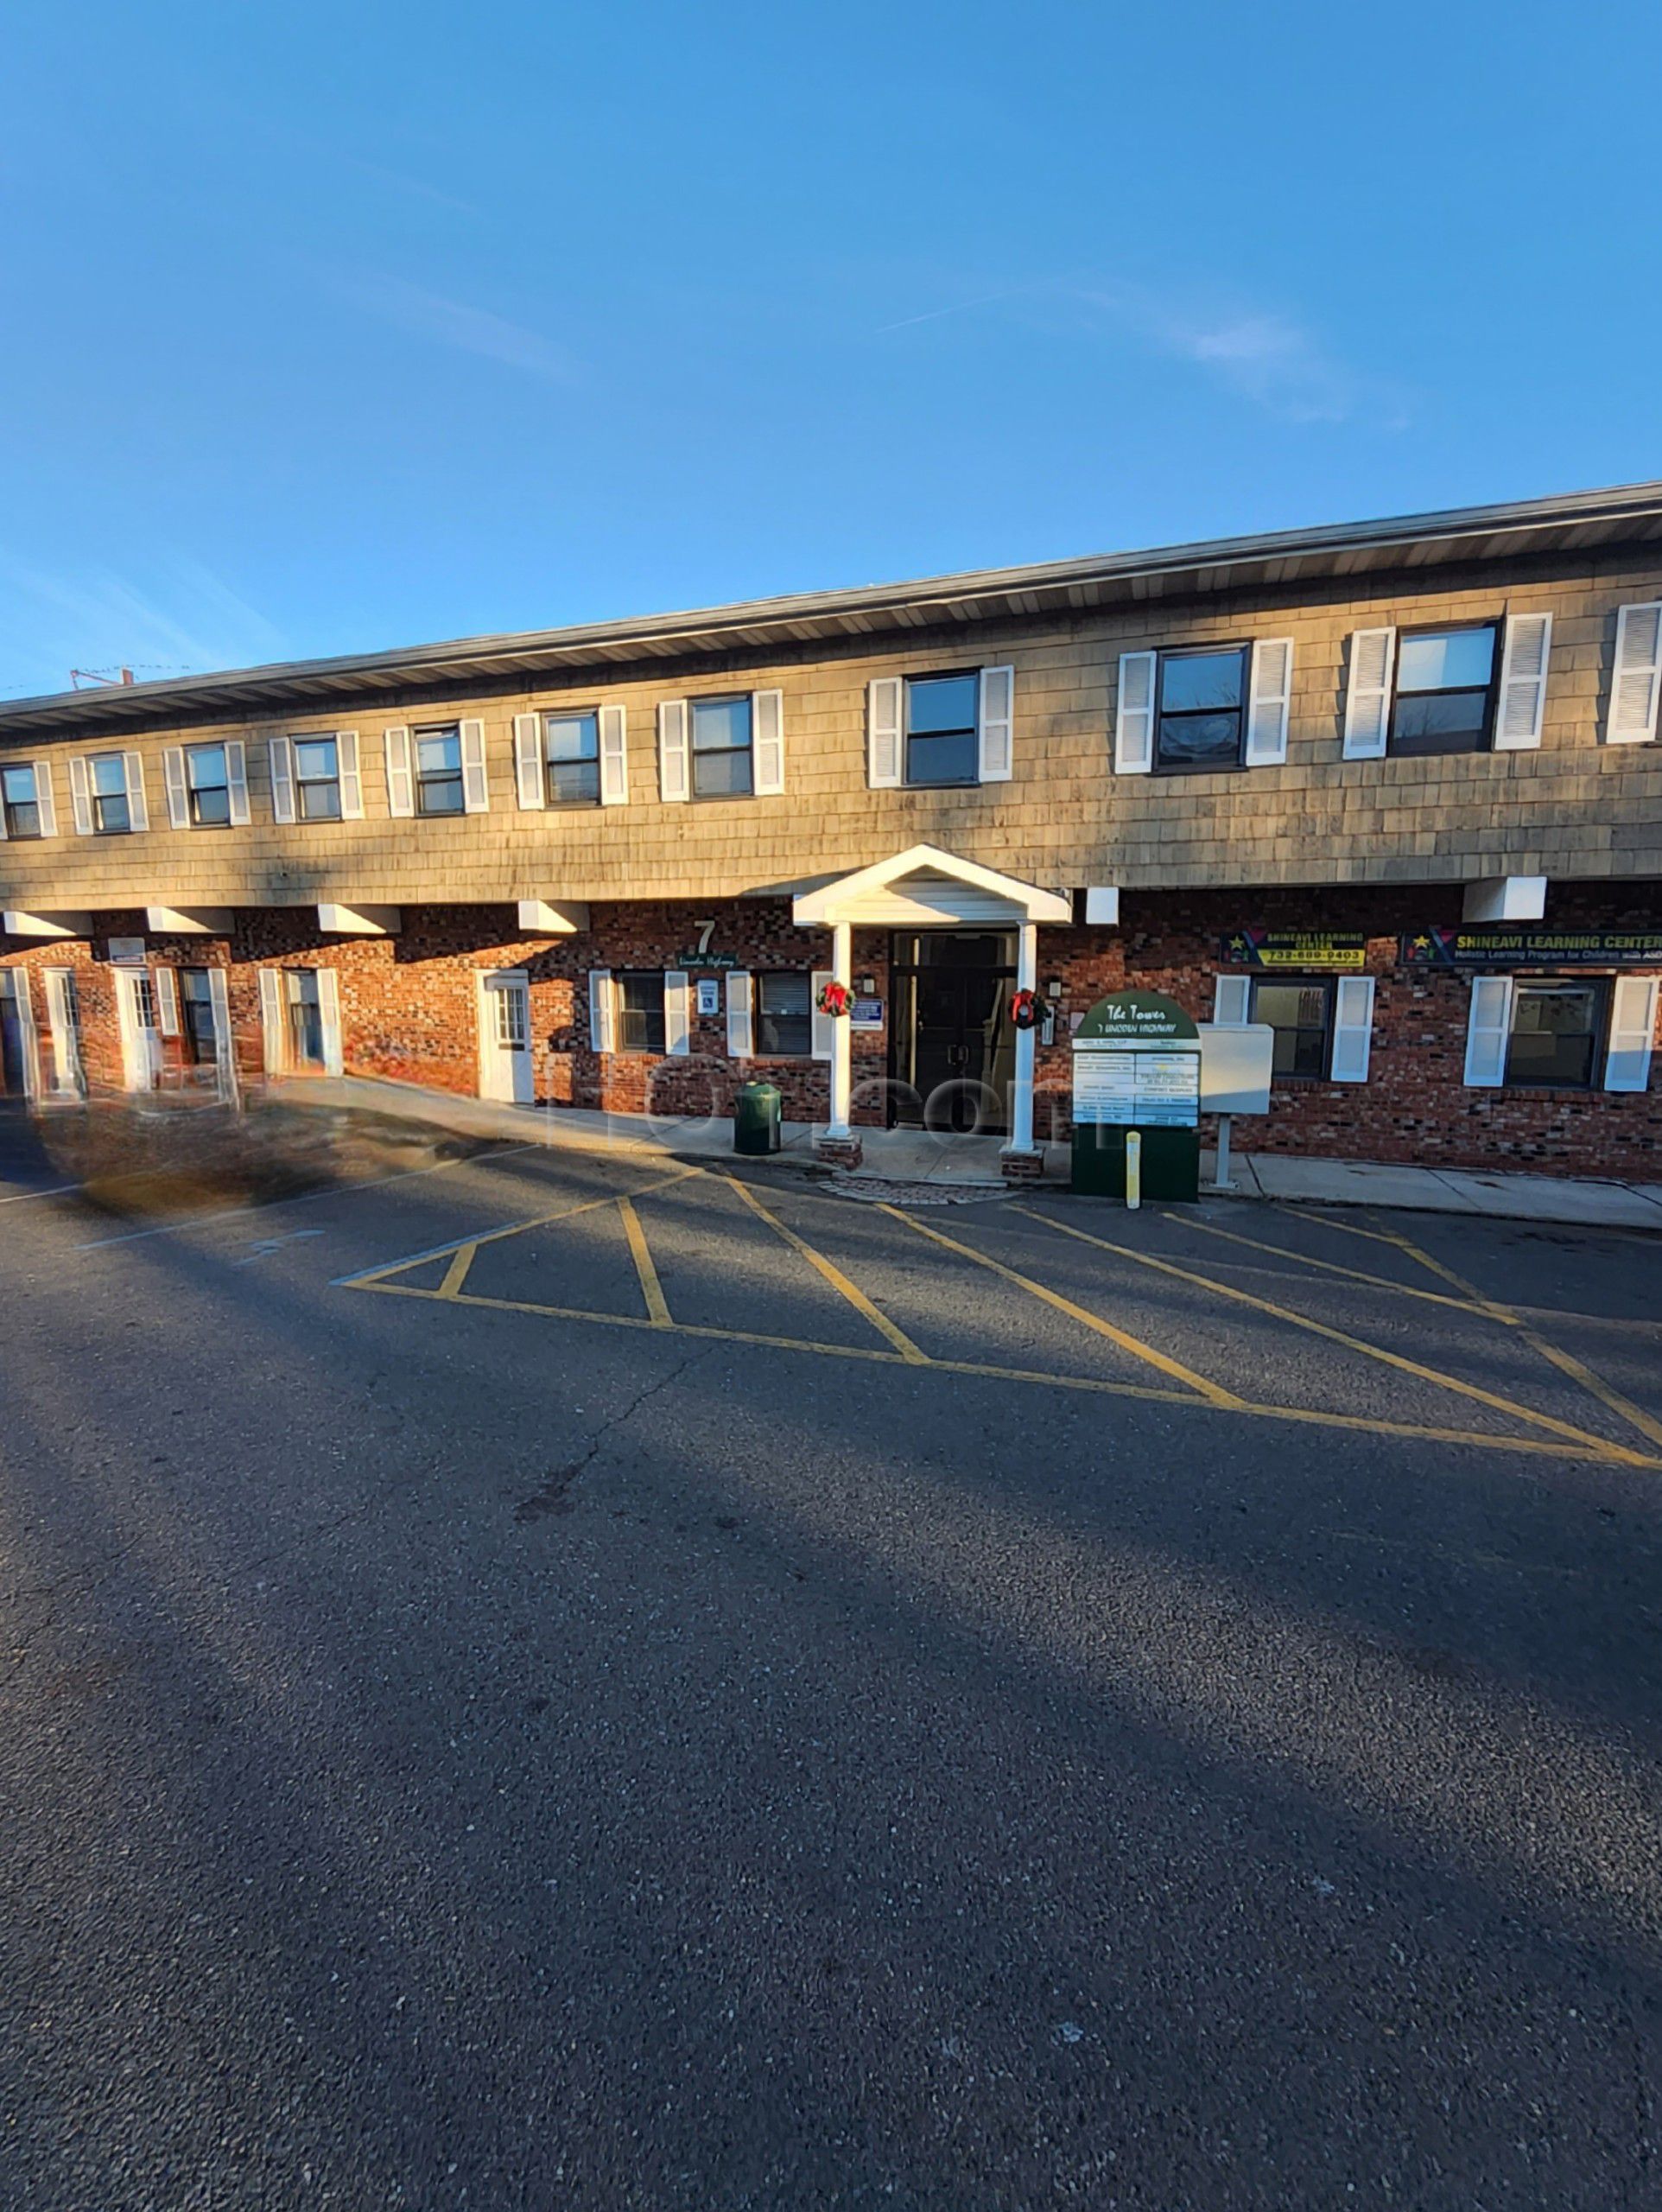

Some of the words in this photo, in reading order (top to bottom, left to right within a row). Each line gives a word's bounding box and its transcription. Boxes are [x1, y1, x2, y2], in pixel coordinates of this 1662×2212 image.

[694, 920, 715, 954] 7
[1314, 932, 1364, 942] LEARNING
[1456, 936, 1523, 948] SHINEAVI
[1526, 936, 1601, 949] LEARNING
[1488, 950, 1526, 961] Learning
[1528, 950, 1565, 961] Program
[1583, 950, 1620, 959] Children
[1107, 1005, 1126, 1020] The
